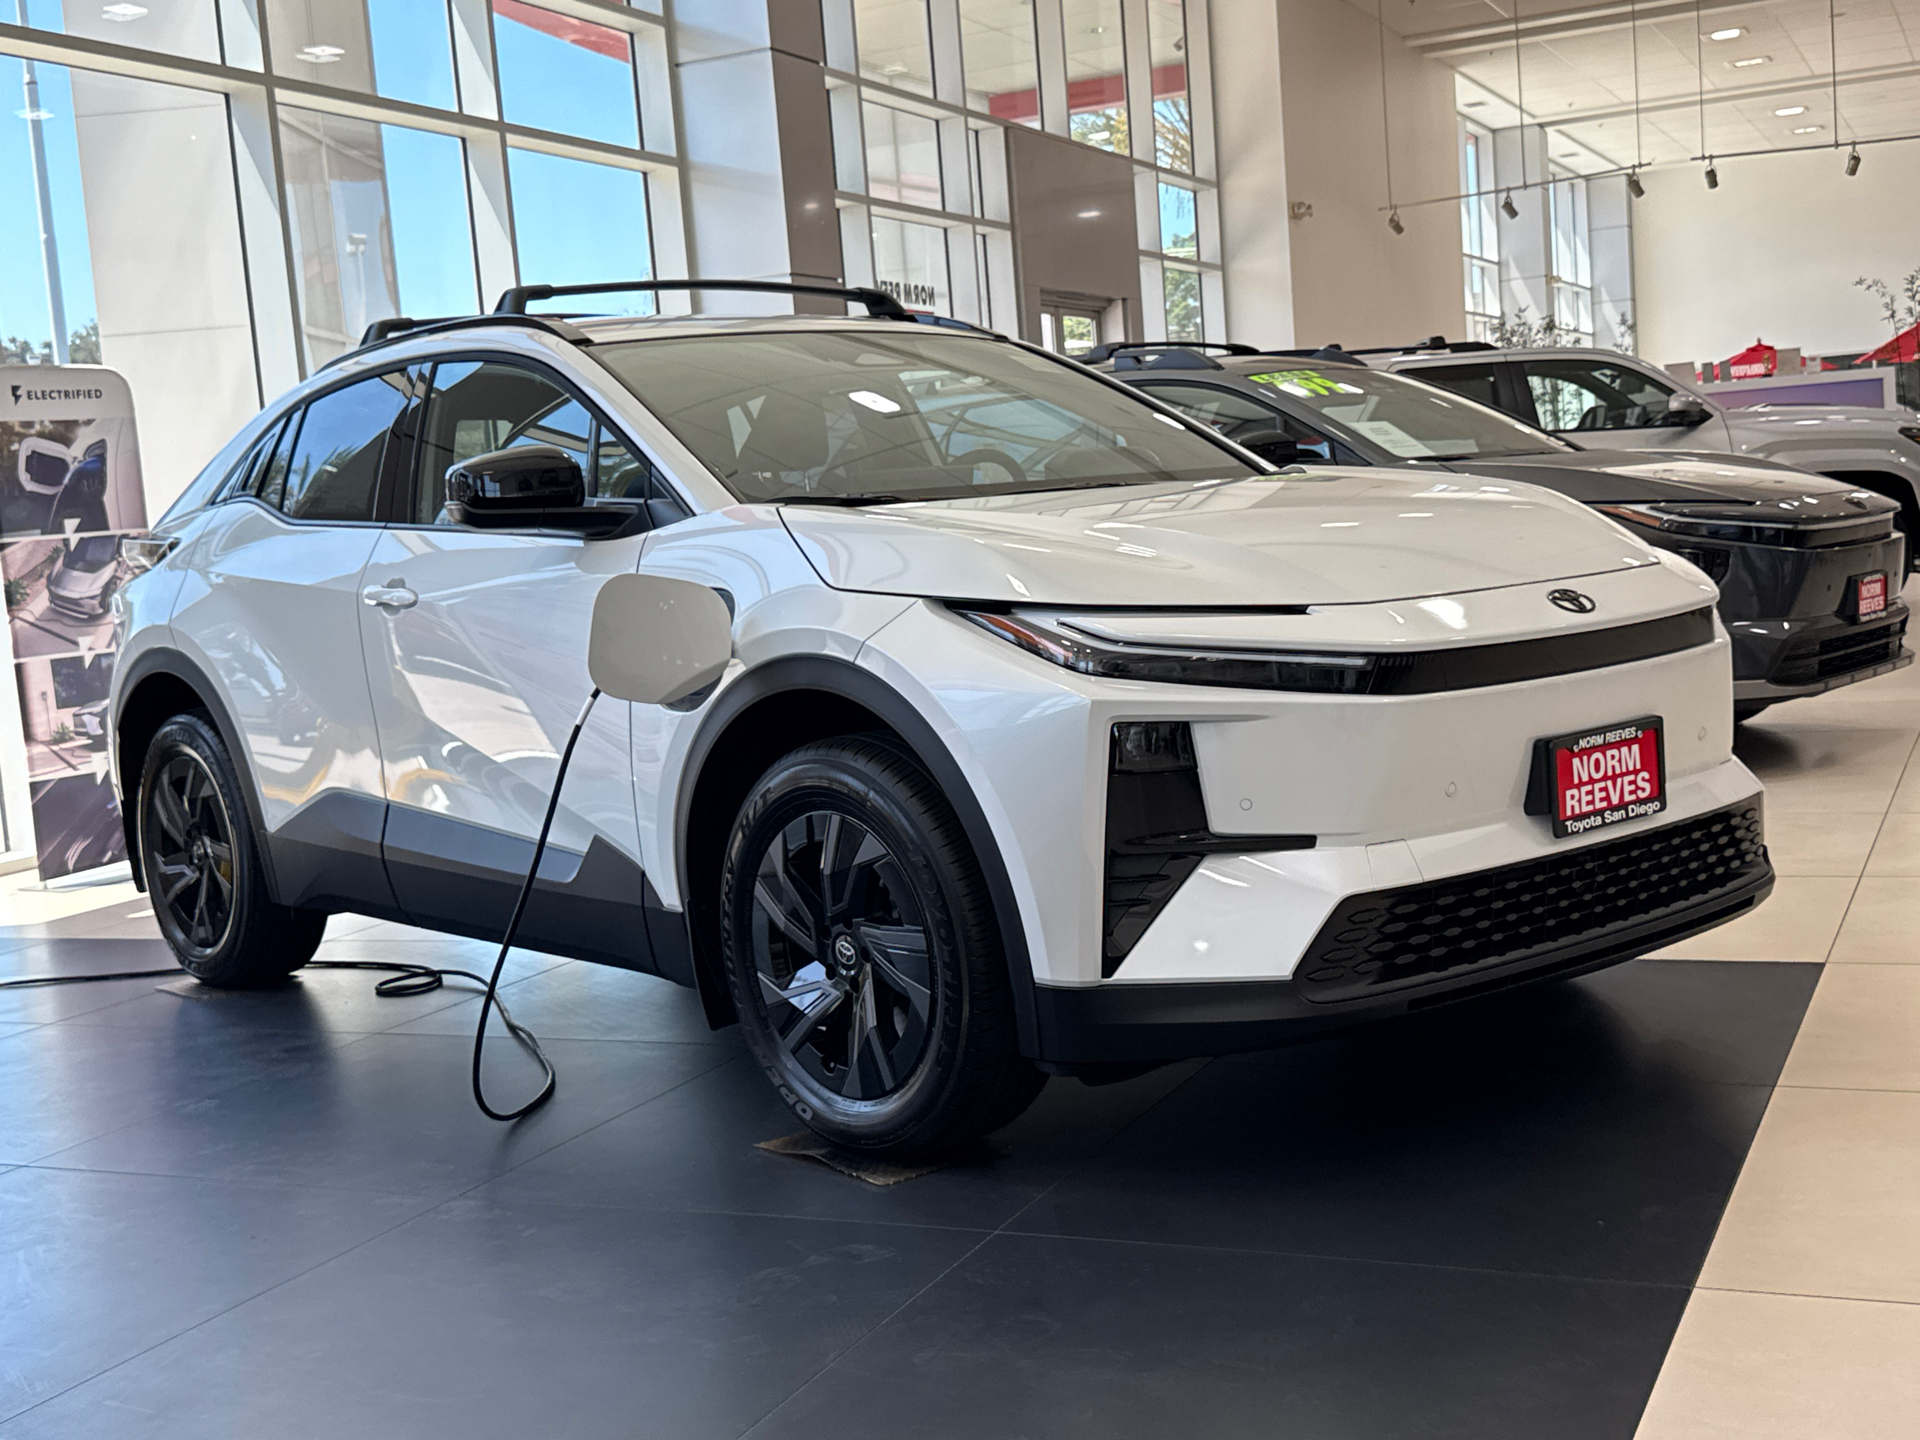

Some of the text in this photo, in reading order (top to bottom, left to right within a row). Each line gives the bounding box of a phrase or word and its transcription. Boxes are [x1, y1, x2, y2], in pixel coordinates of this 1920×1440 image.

[26, 389, 103, 400] ELECTRIFIED
[1579, 727, 1636, 749] NORM REEVES
[1572, 744, 1641, 784] NORM
[1565, 771, 1651, 816] REEVES
[1565, 801, 1660, 833] Toyota San Diego
[753, 1046, 814, 1121] OPEN
